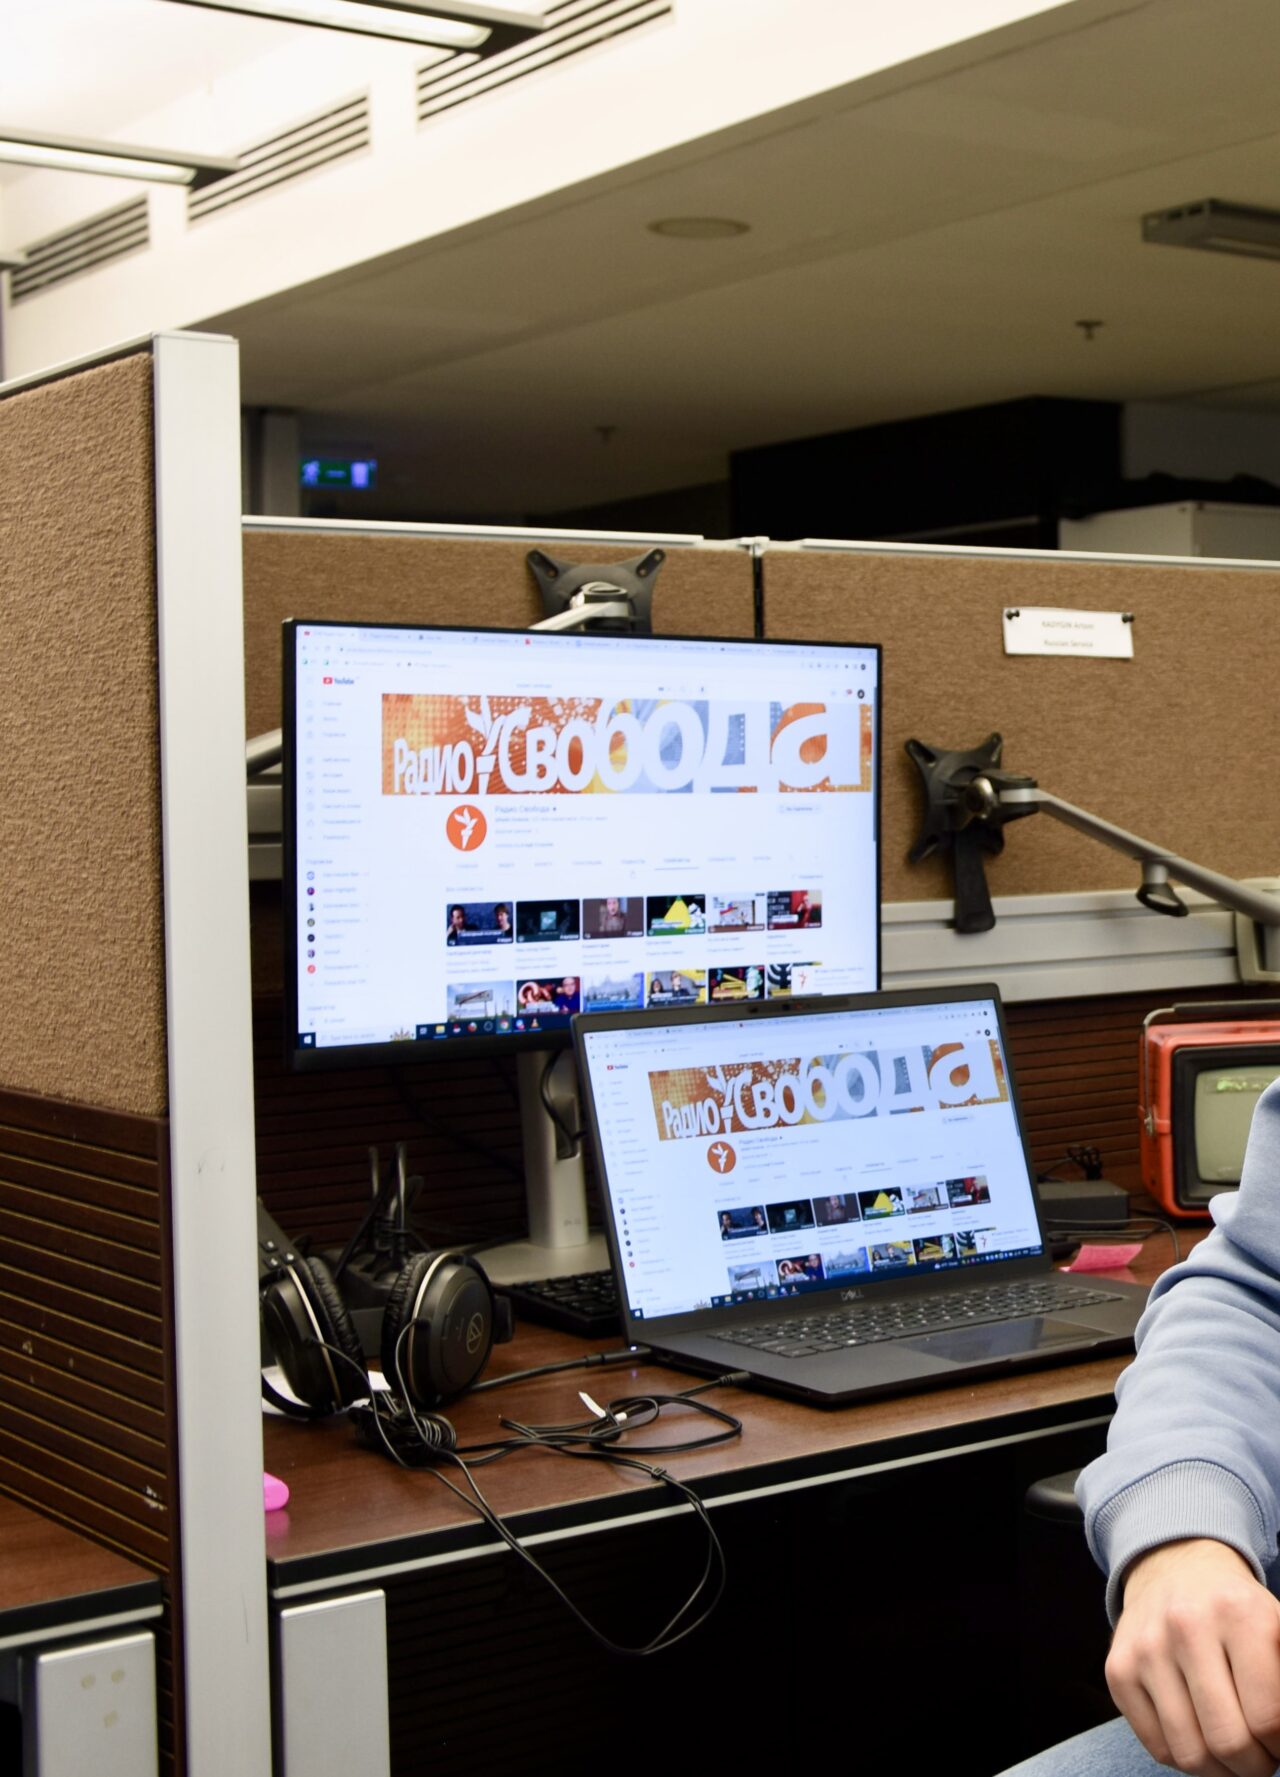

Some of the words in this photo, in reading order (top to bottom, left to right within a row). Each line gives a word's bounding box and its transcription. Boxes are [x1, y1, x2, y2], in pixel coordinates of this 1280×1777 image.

[393, 738, 475, 796] Радио
[661, 1098, 722, 1141] Радио
[839, 1287, 865, 1302] DELL
